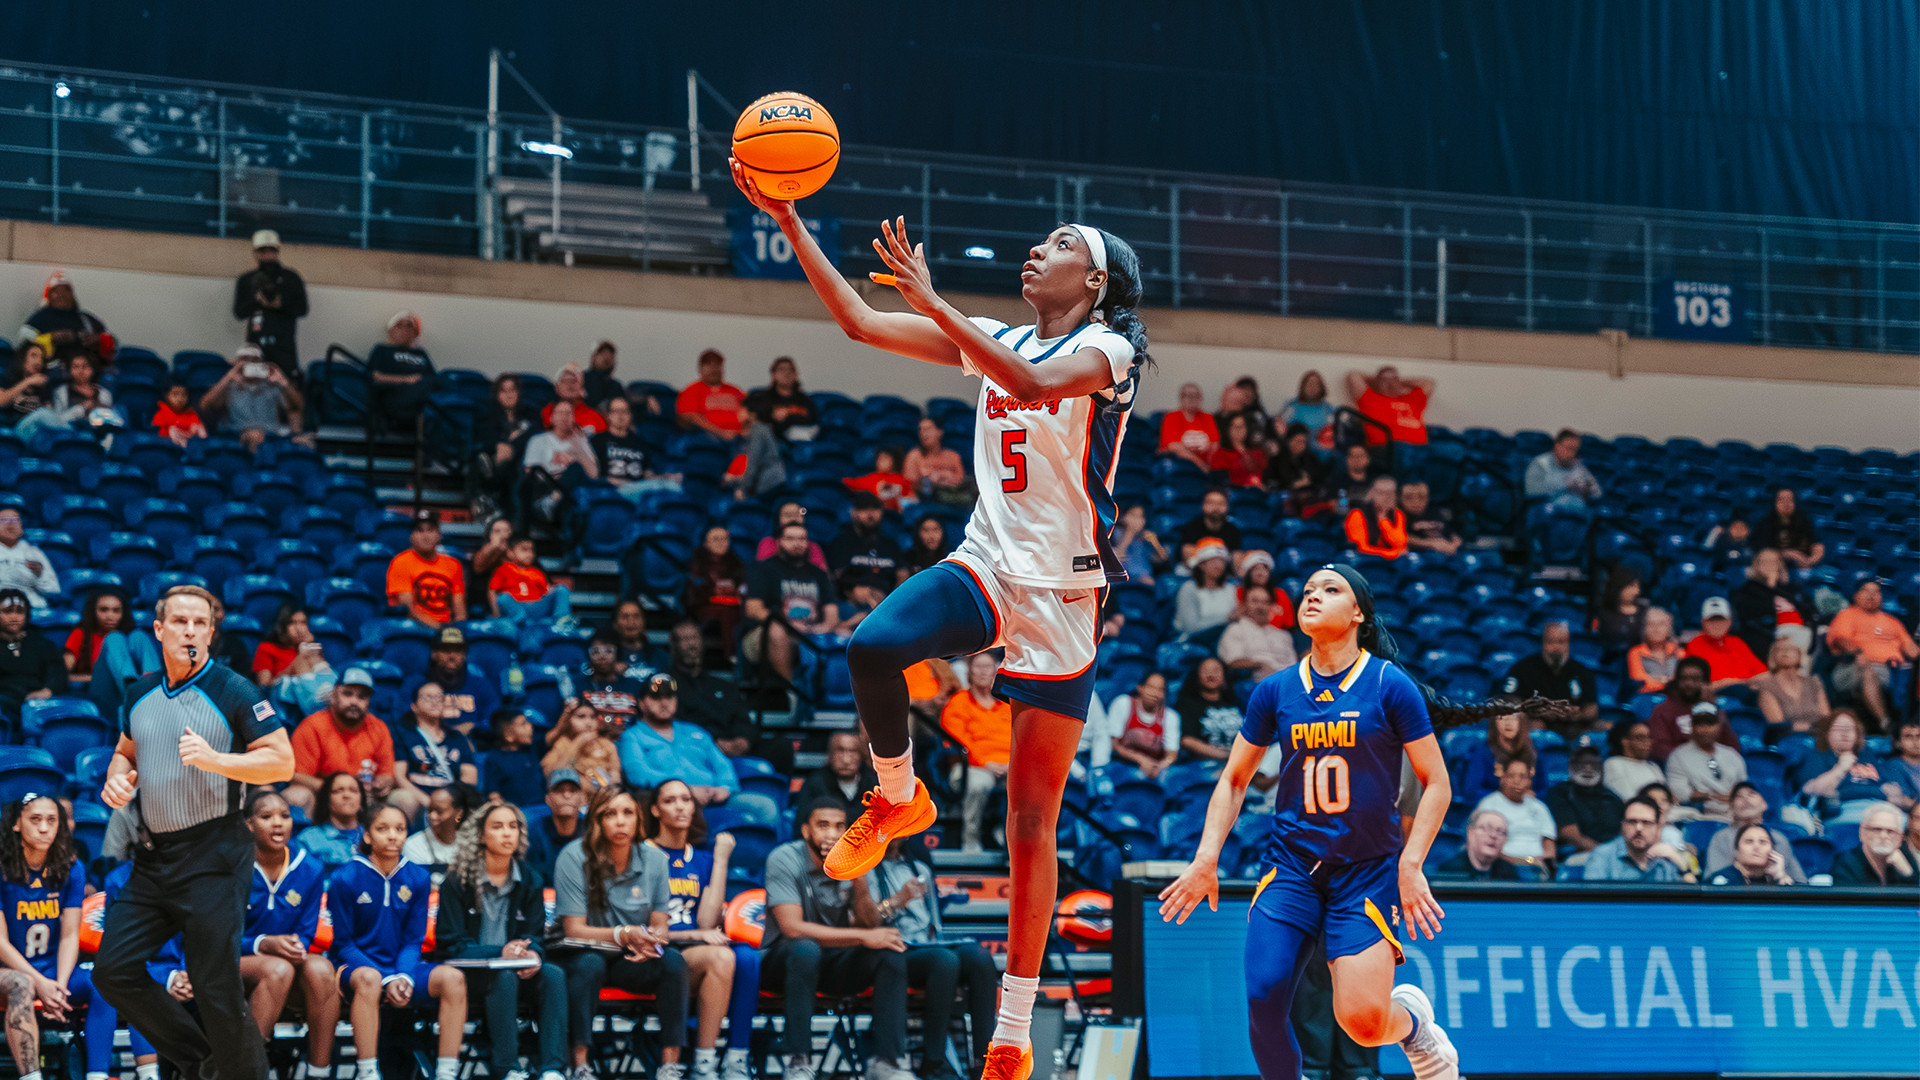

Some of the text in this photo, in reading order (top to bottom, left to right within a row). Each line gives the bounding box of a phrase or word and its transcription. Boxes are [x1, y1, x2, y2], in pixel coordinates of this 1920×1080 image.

[759, 105, 813, 123] NCAA
[753, 231, 820, 263] 10
[1674, 295, 1731, 328] 103
[1001, 428, 1028, 493] 5
[1291, 720, 1357, 750] PVAMU
[1302, 755, 1350, 814] 10
[16, 899, 60, 920] PVAMU
[1757, 945, 1920, 1028] HVA
